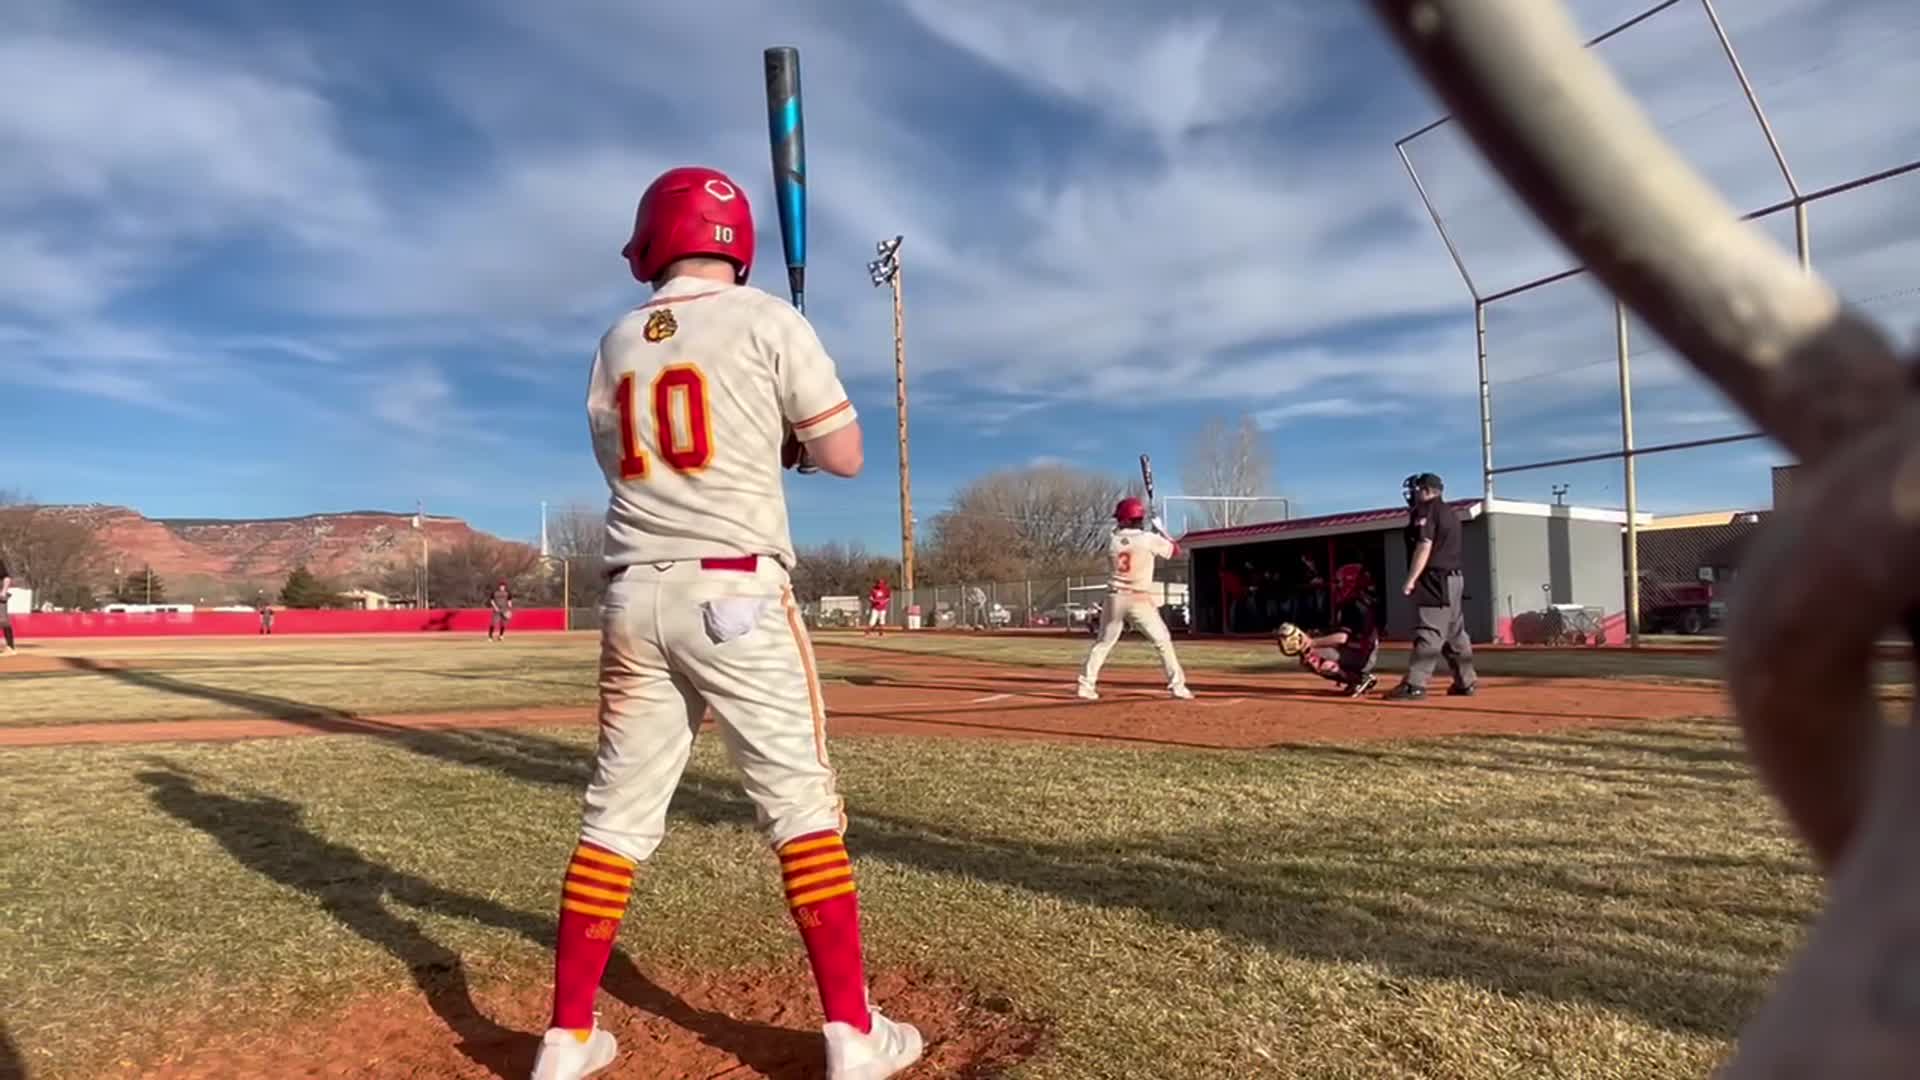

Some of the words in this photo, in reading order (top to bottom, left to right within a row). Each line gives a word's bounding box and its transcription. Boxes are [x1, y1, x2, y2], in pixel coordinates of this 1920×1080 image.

[715, 224, 734, 244] 10
[613, 362, 714, 481] 10
[1117, 551, 1131, 574] 3
